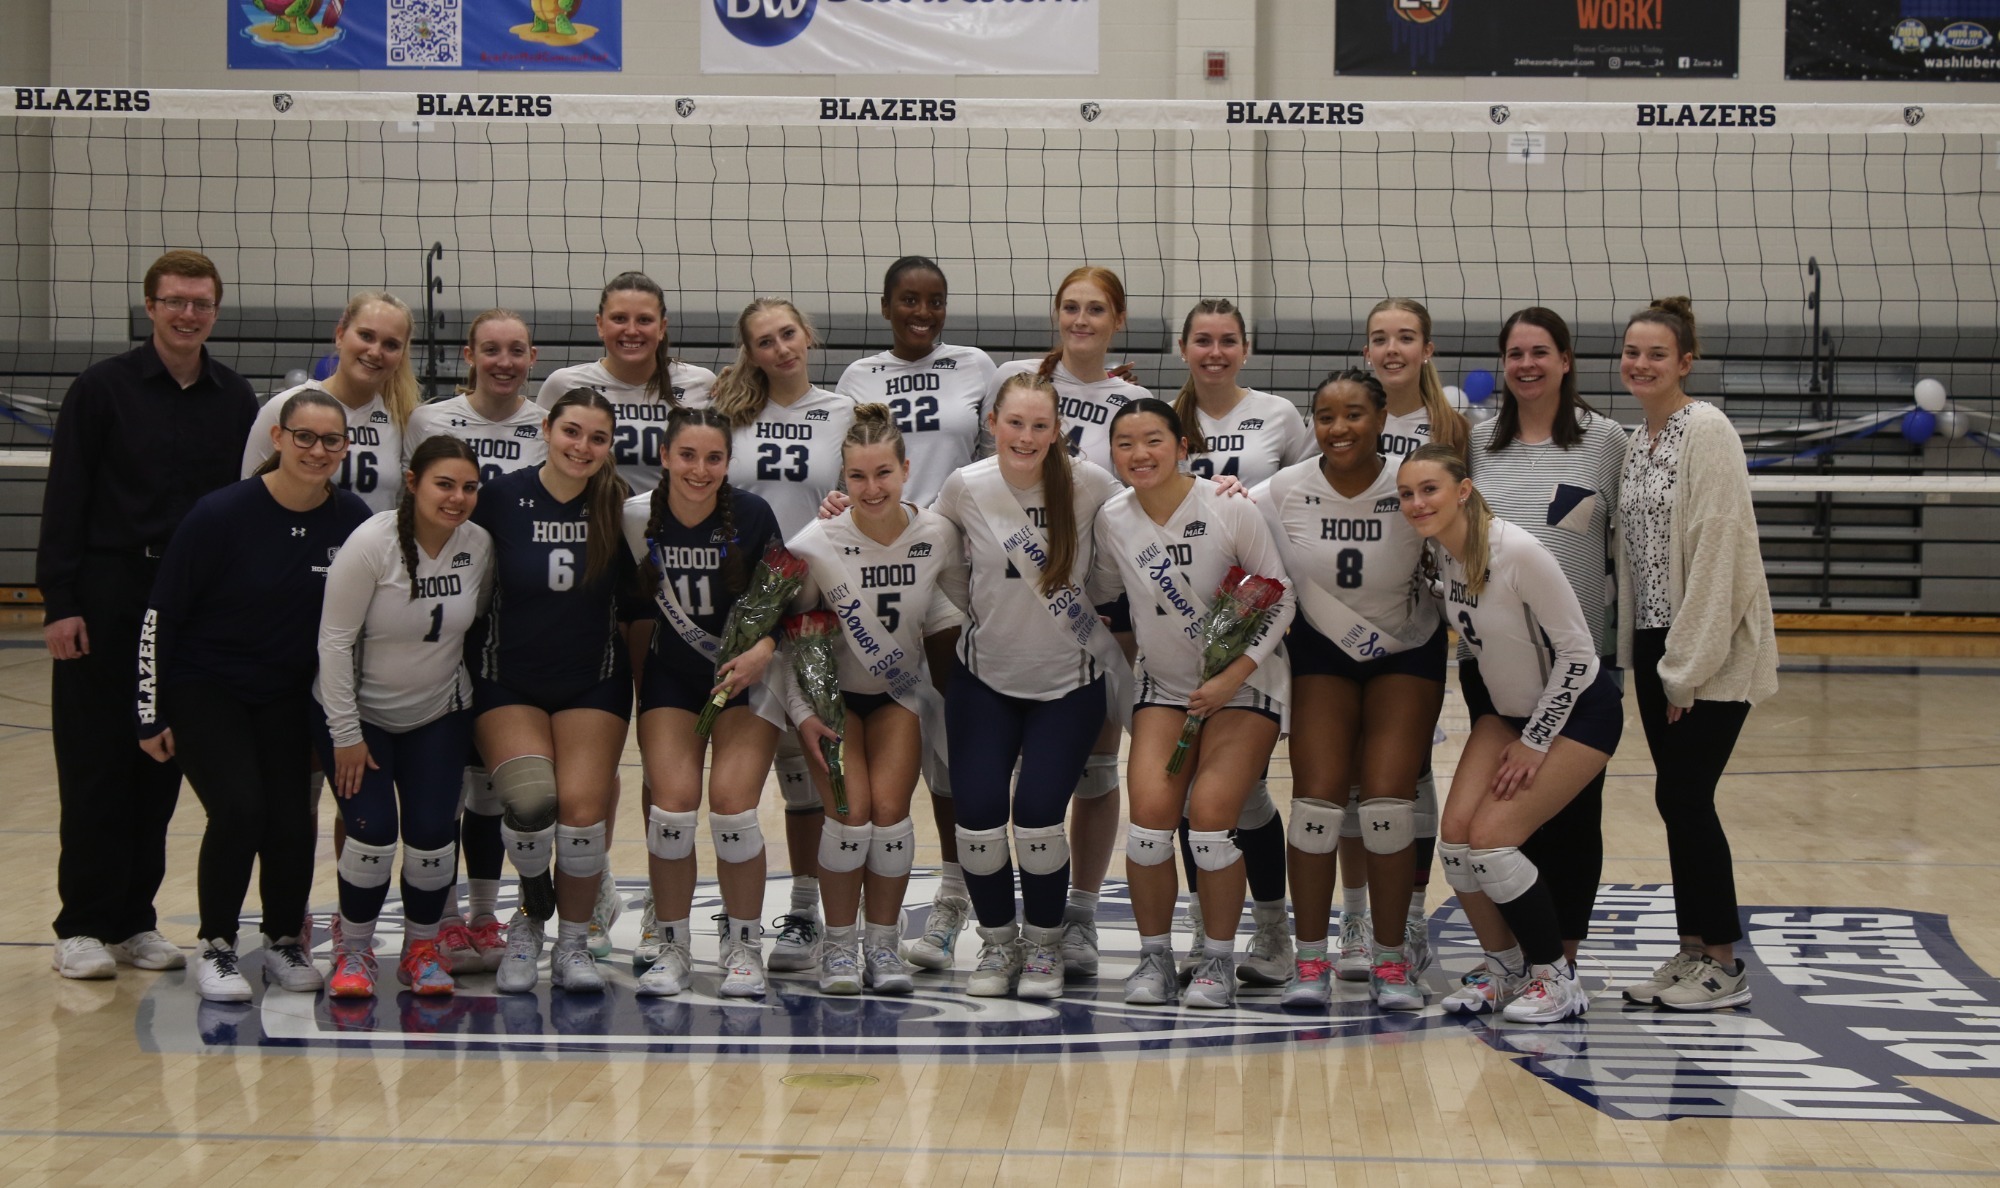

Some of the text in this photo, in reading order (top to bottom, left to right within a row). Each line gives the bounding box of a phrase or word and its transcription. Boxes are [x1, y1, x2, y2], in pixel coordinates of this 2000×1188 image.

[1577, 0, 1662, 29] WORK!
[1598, 44, 1627, 53] Contact
[1642, 44, 1663, 55] Today
[16, 89, 150, 112] BLAZERS
[417, 94, 551, 117] BLAZERS
[820, 99, 956, 121] BLAZERS
[1227, 103, 1364, 125] BLAZERS
[1637, 105, 1776, 127] BLAZERS
[886, 373, 940, 395] HOOD
[888, 396, 940, 433] 22
[347, 425, 380, 446] OOD
[756, 422, 812, 440] HOOD
[1205, 434, 1244, 452] OOD
[614, 425, 665, 466] 20
[1378, 433, 1420, 455] OOD
[338, 451, 378, 493] 16
[757, 443, 809, 482] 23
[532, 520, 588, 542] HOOD
[1002, 524, 1034, 553] AINSLEE
[1321, 518, 1382, 541] HOOD
[663, 546, 720, 570] HOOD
[1135, 542, 1161, 568] JACKIE
[548, 548, 575, 591] 6
[861, 564, 916, 588] HOOD
[1336, 548, 1363, 589] 8
[675, 574, 715, 616] 11
[827, 582, 850, 603] CASEY
[1149, 557, 1196, 619] Senior
[422, 603, 443, 643] 1
[877, 592, 901, 634] 5
[1070, 612, 1089, 633] HOOD
[682, 627, 707, 643] 2025
[837, 599, 870, 656] Senior
[1076, 617, 1098, 646] COLLEGE
[1340, 623, 1367, 648] OLIVIA
[1458, 610, 1483, 651] 2
[138, 608, 158, 724] BLAZERS
[869, 648, 904, 676] 2025
[1530, 662, 1588, 745] BLAZERS
